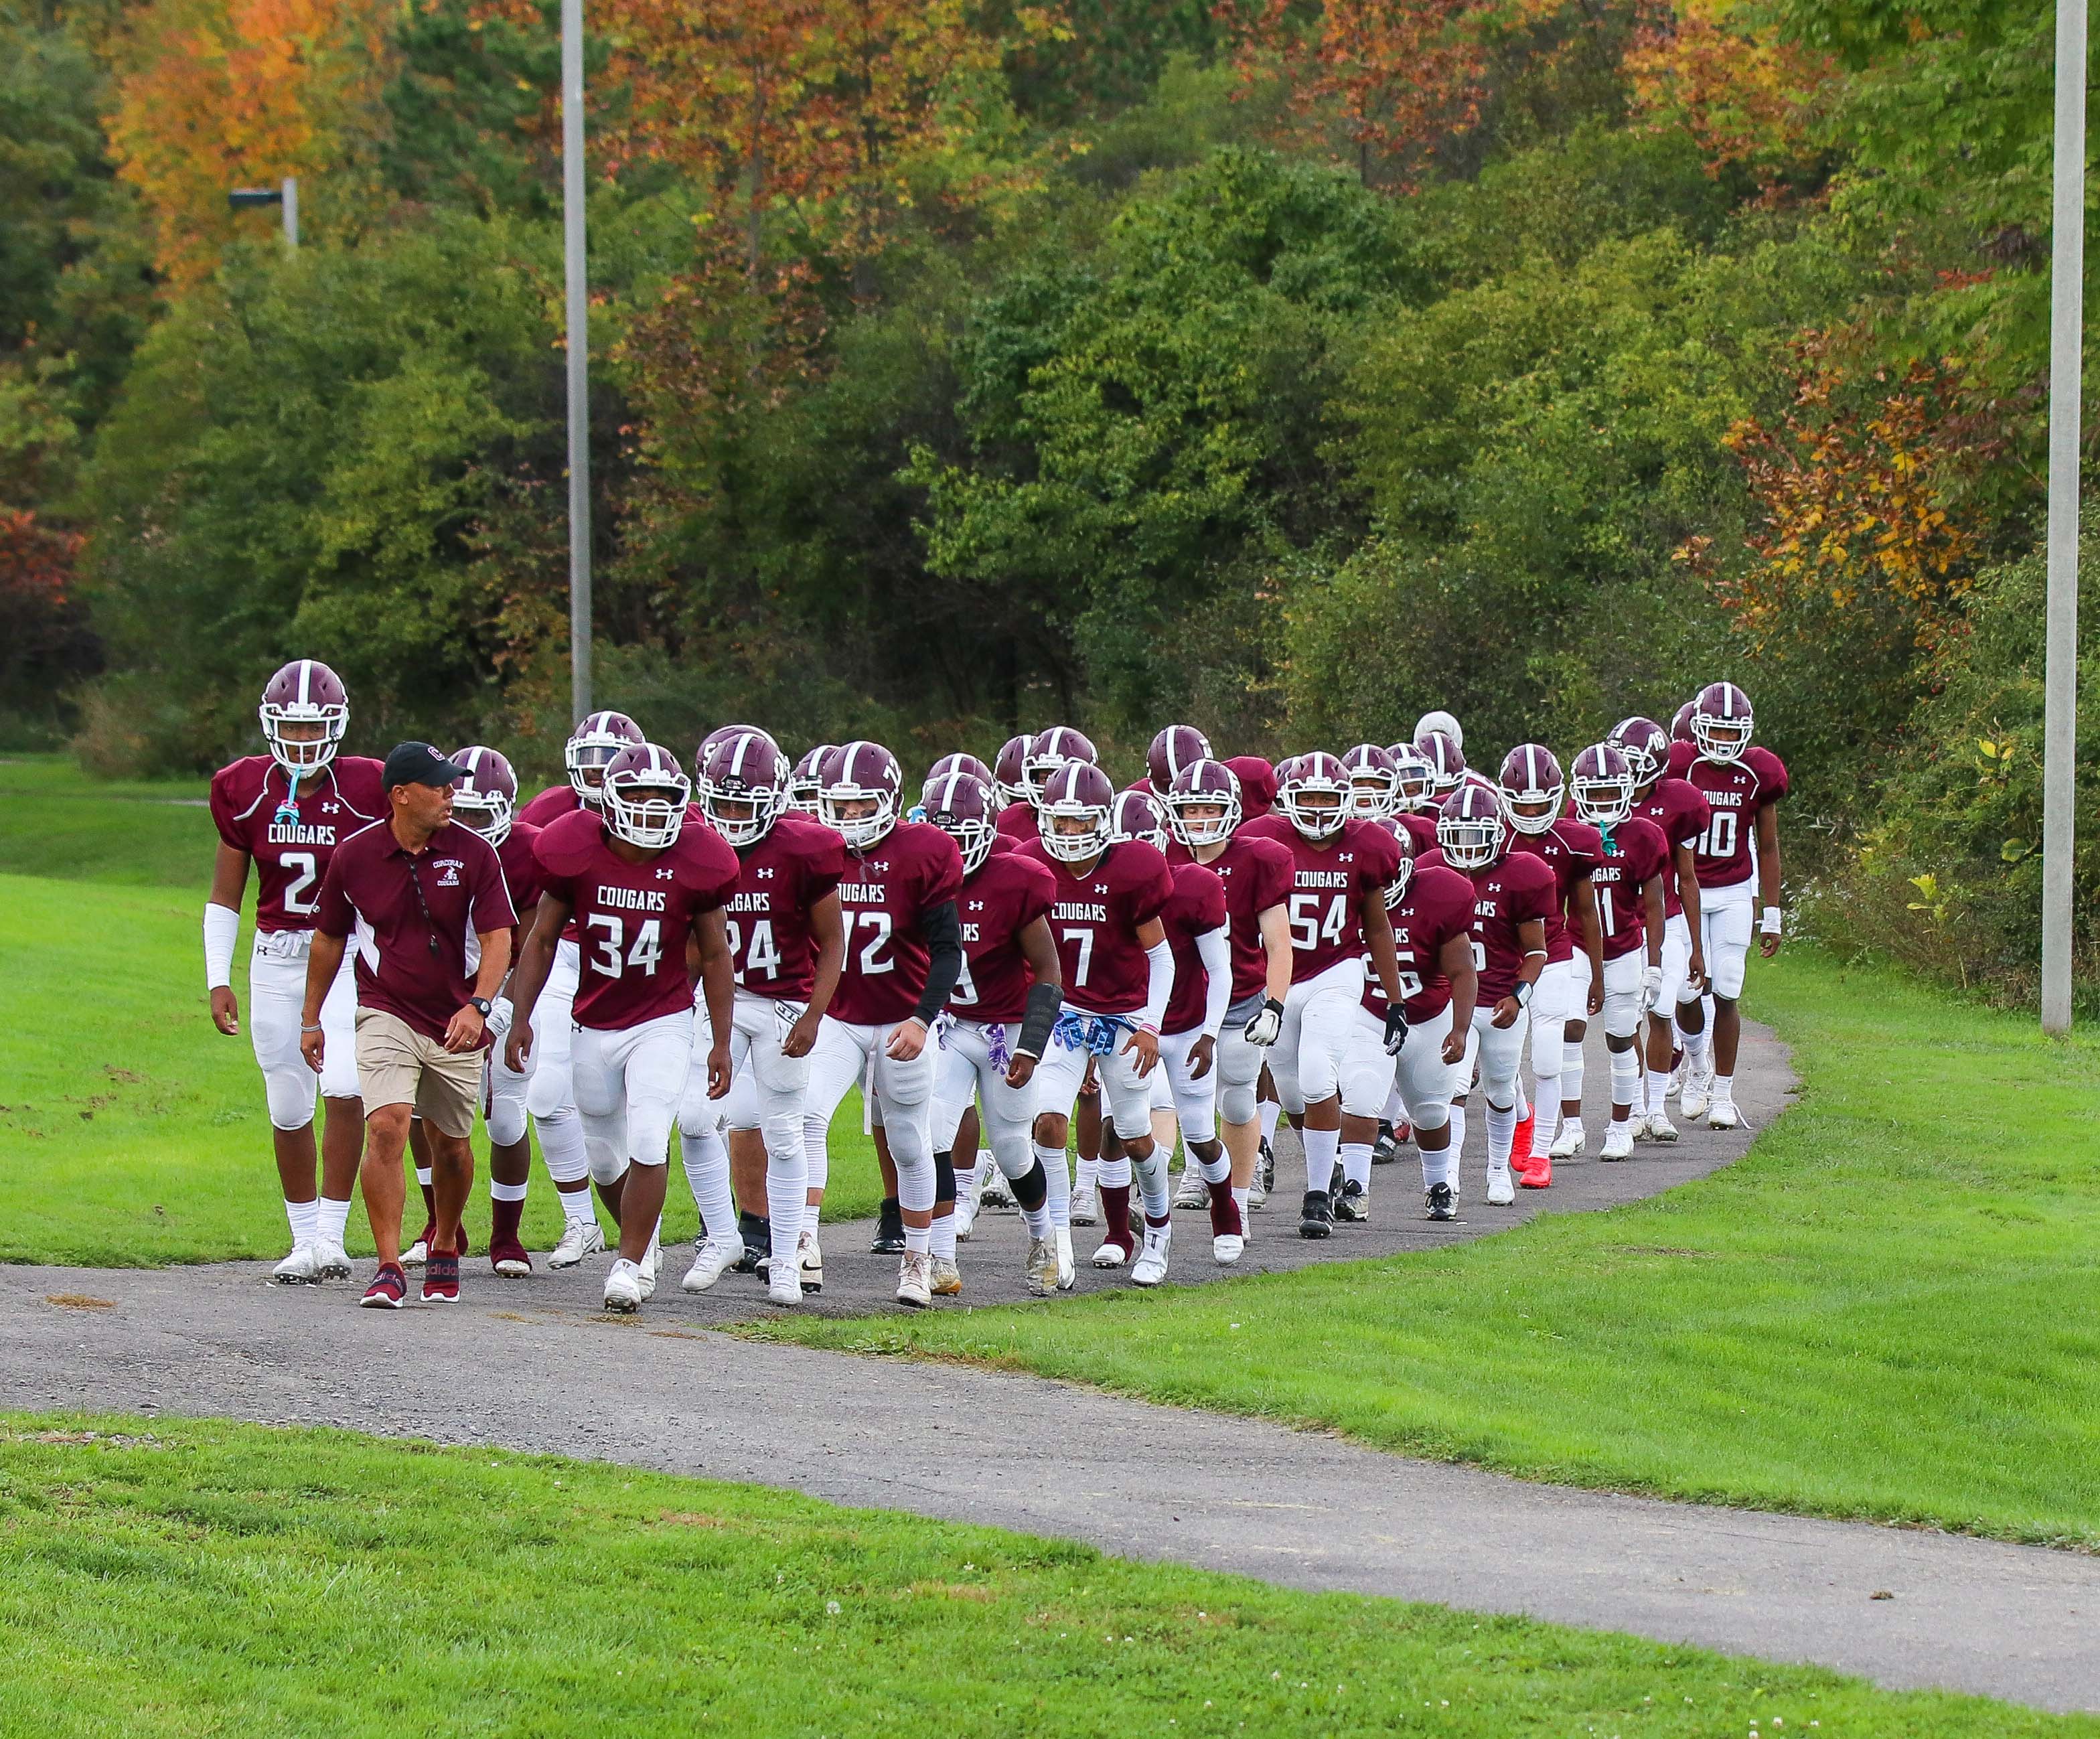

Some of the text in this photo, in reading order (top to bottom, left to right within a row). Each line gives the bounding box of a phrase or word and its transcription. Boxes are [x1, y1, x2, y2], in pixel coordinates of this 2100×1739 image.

[268, 824, 335, 845] COUGARS
[433, 859, 465, 869] CORCORAN
[280, 852, 315, 913] 2
[1294, 871, 1348, 888] COUGARS
[597, 885, 666, 911] COUGARS
[1051, 902, 1106, 922] COUGARS
[1290, 894, 1347, 950] 54
[587, 913, 663, 978] 34
[1063, 928, 1094, 987] 7
